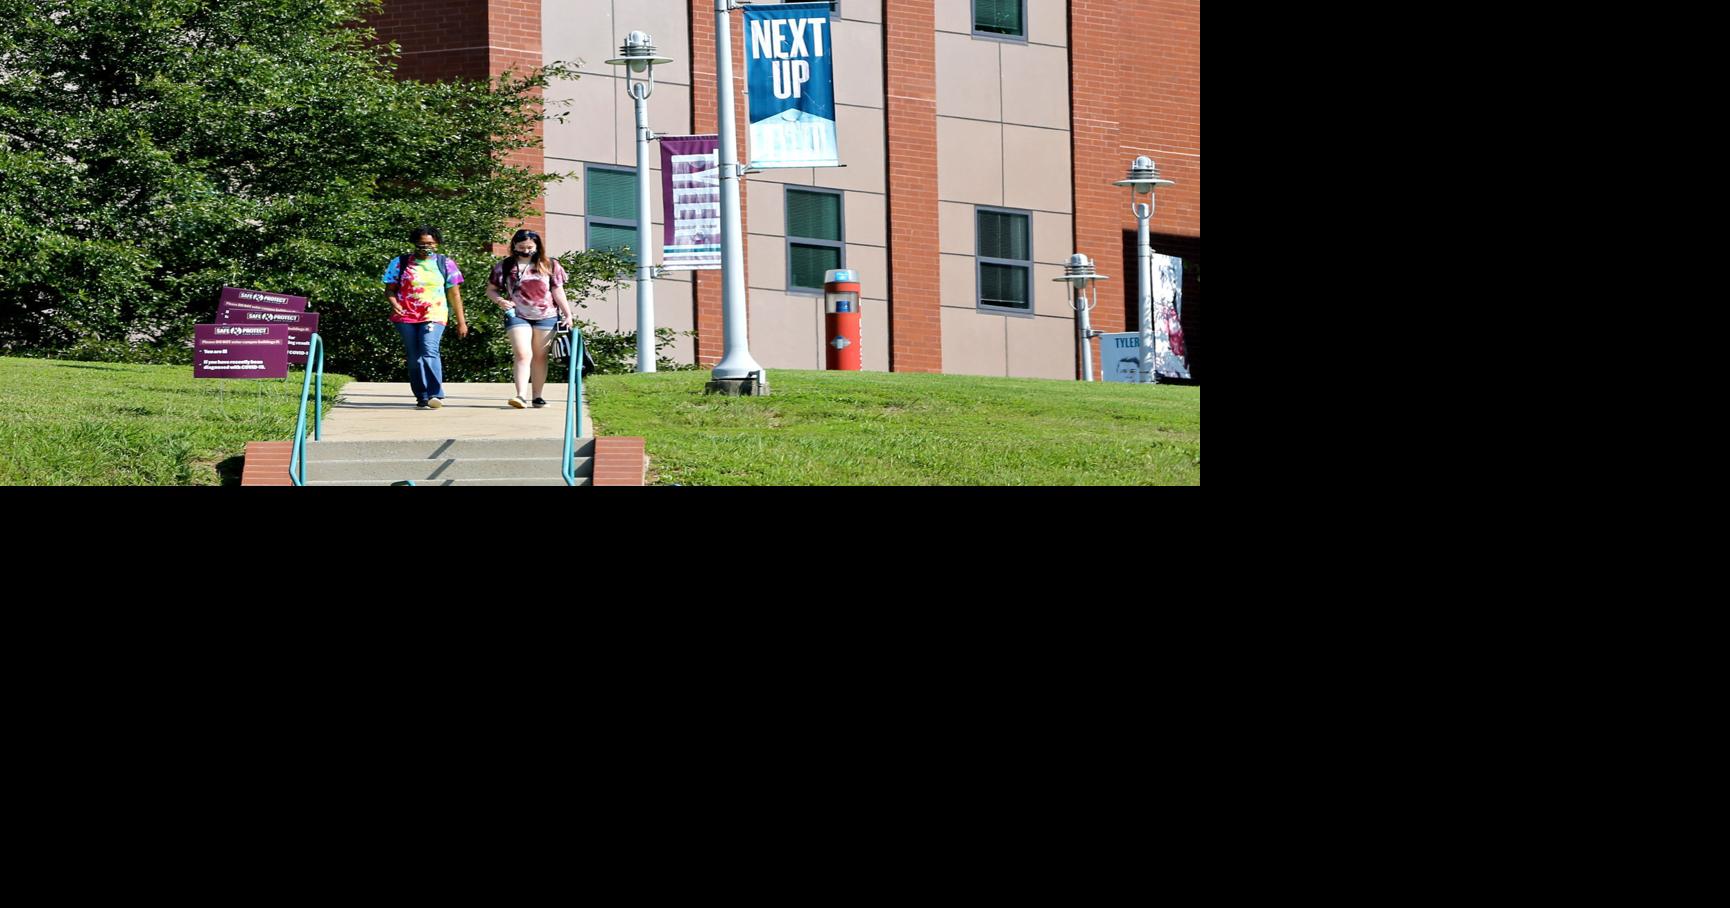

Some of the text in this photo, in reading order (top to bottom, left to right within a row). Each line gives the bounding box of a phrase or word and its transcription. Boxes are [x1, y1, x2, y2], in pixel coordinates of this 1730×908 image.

[750, 17, 827, 59] NEXT
[771, 59, 811, 100] UP
[273, 314, 298, 322] PROTECT
[1115, 338, 1140, 349] TYLER
